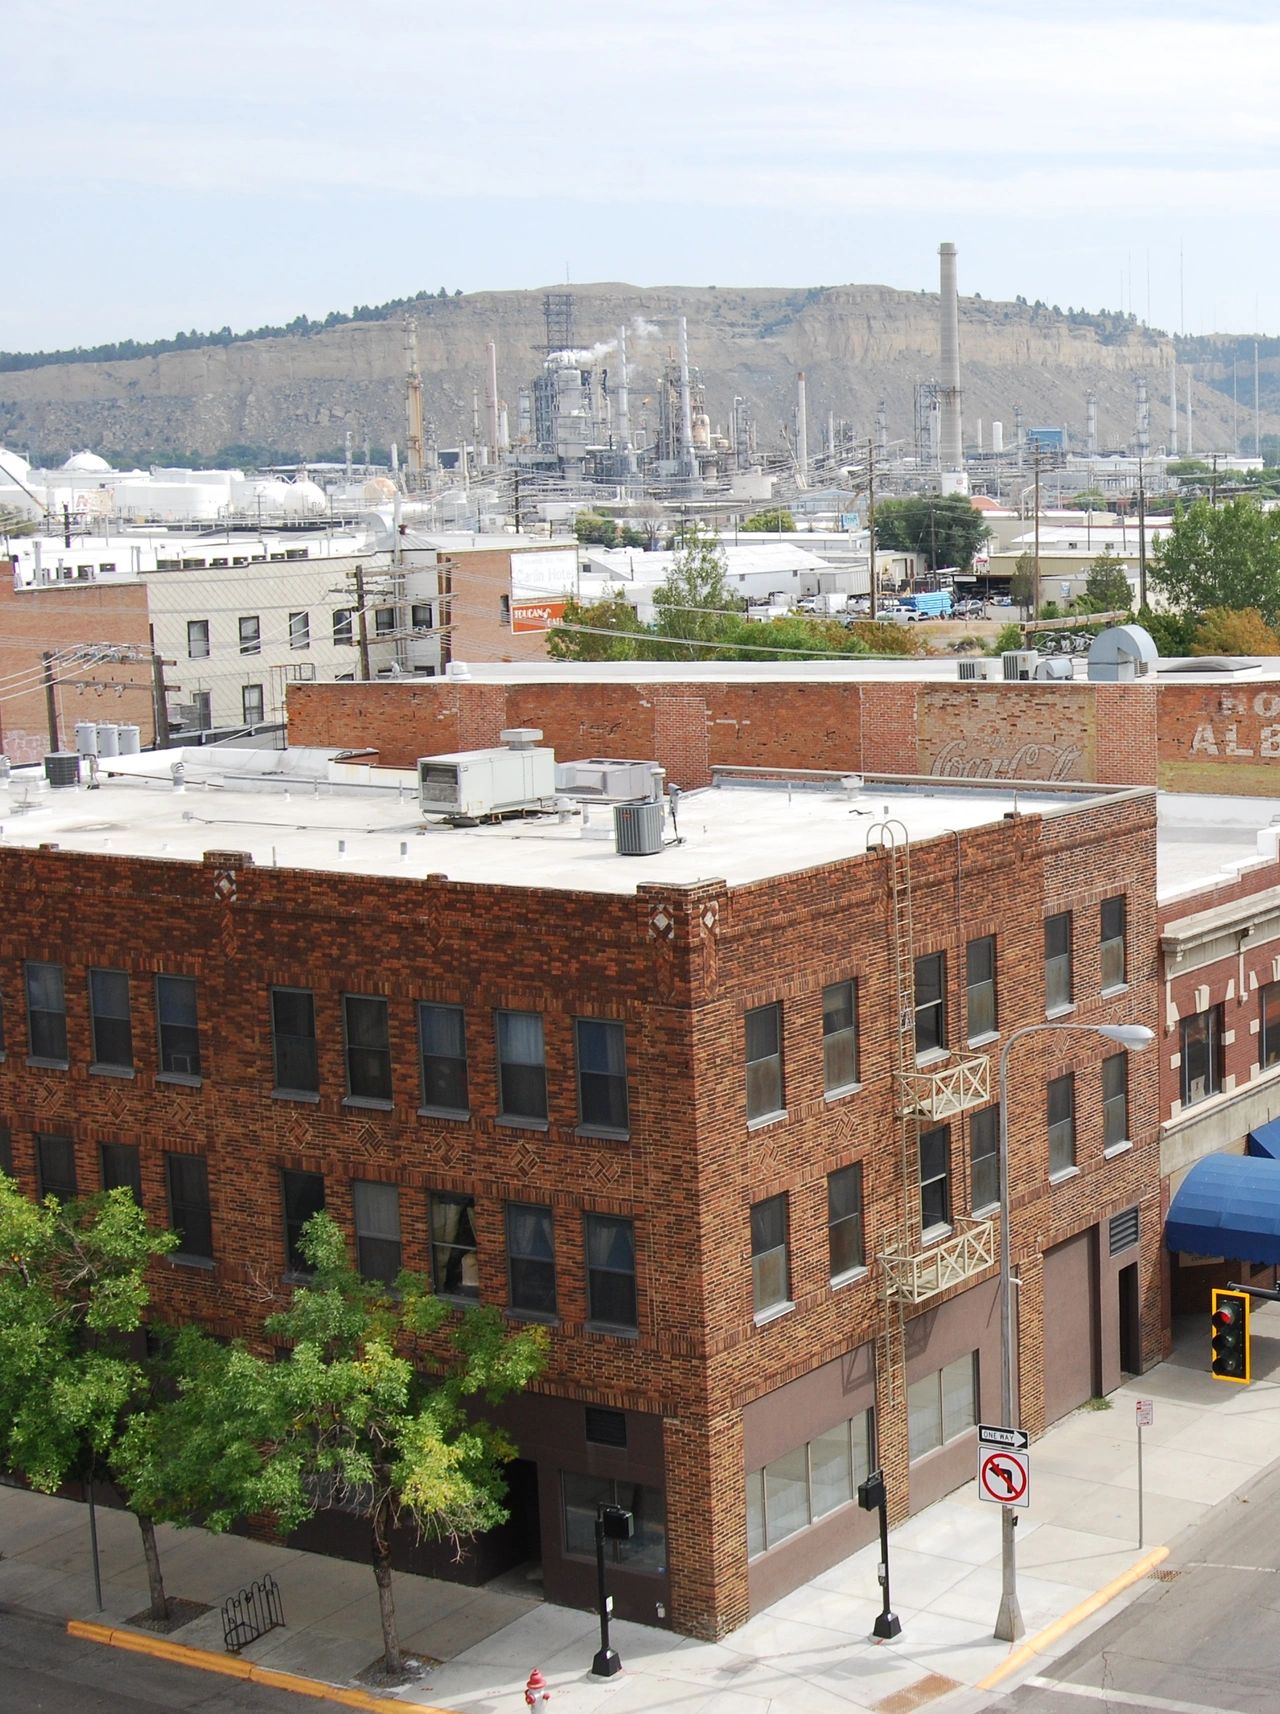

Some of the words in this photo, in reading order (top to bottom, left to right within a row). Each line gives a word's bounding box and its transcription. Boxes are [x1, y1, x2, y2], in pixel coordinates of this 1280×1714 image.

[930, 740, 1084, 782] Coca-Cl
[983, 1430, 997, 1440] ONE
[999, 1433, 1014, 1442] WAY
